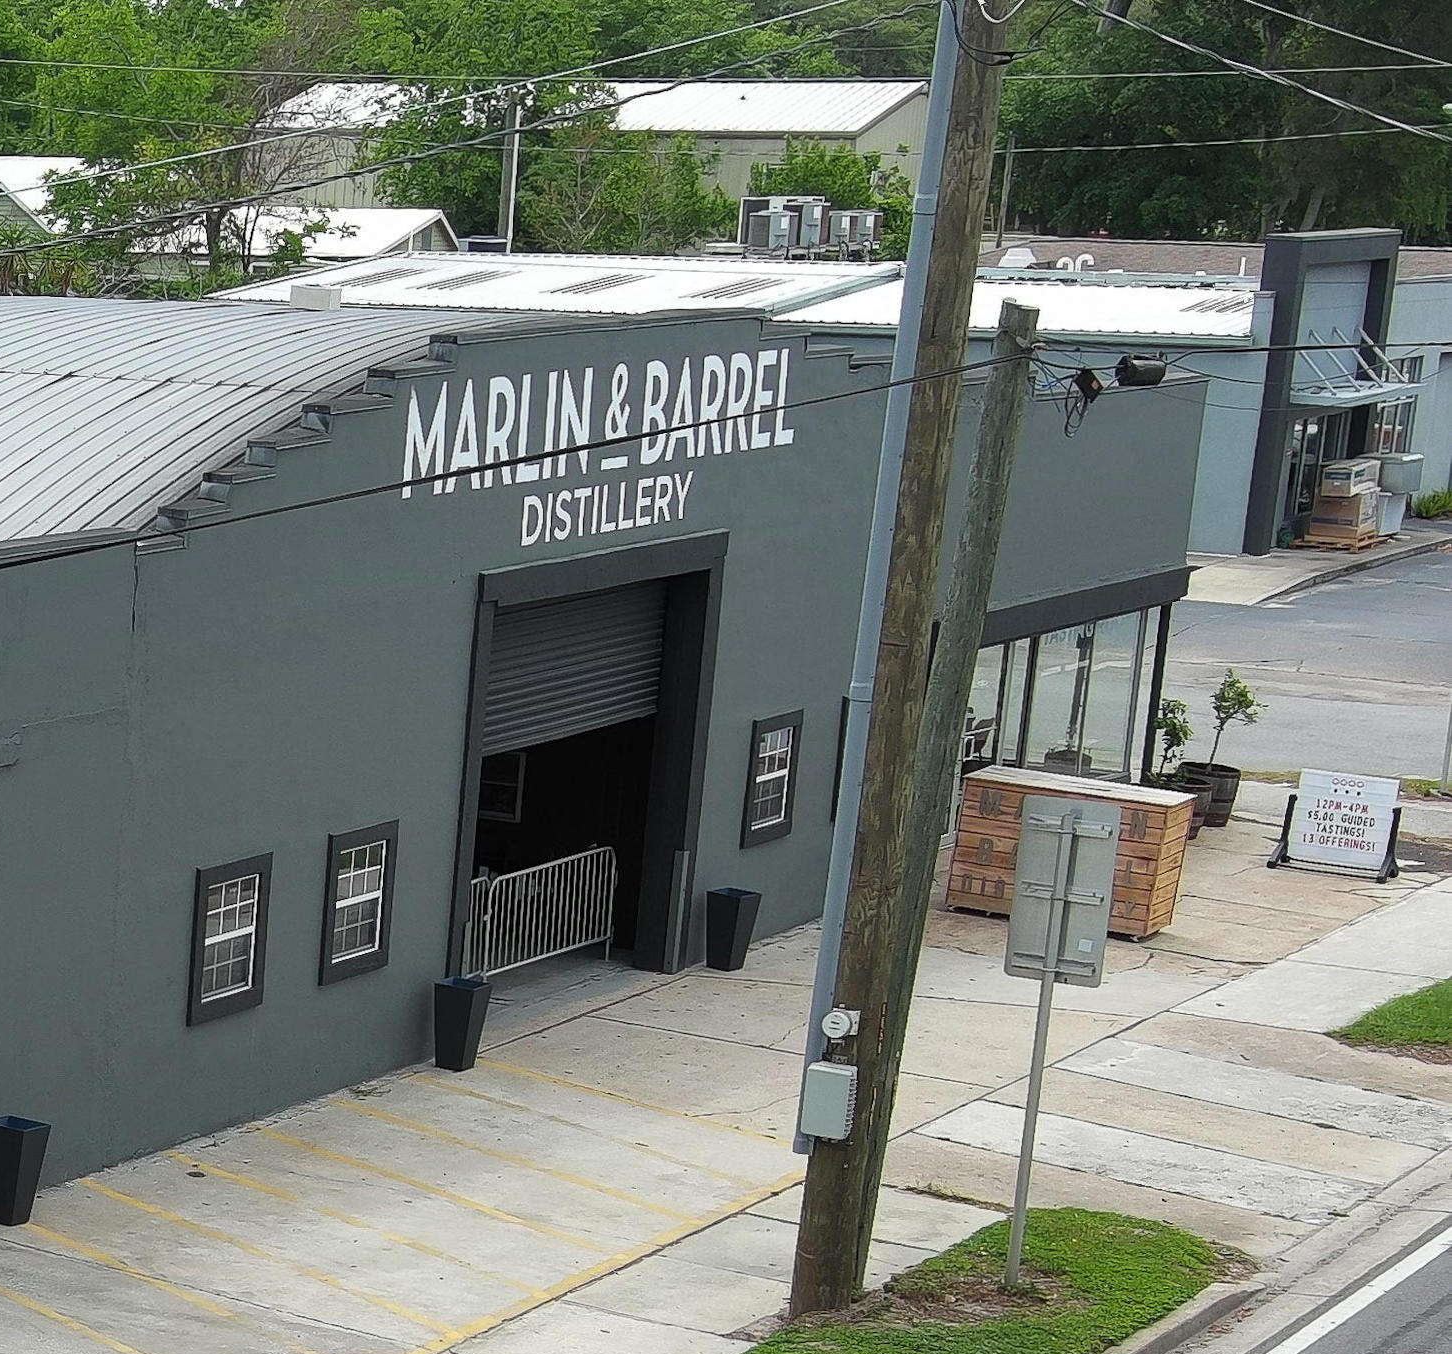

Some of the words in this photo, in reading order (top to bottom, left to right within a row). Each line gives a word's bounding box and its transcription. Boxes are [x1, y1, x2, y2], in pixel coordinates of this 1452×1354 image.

[401, 367, 594, 500] MARLIN
[600, 361, 630, 471] &
[640, 348, 794, 466] BARREL
[520, 470, 694, 547] DISTILLERY
[1341, 813, 1376, 828] GUIDED
[1316, 822, 1365, 839] TASTINGS!
[1303, 833, 1315, 844] 13
[1318, 835, 1376, 852] OFFERINGS!
